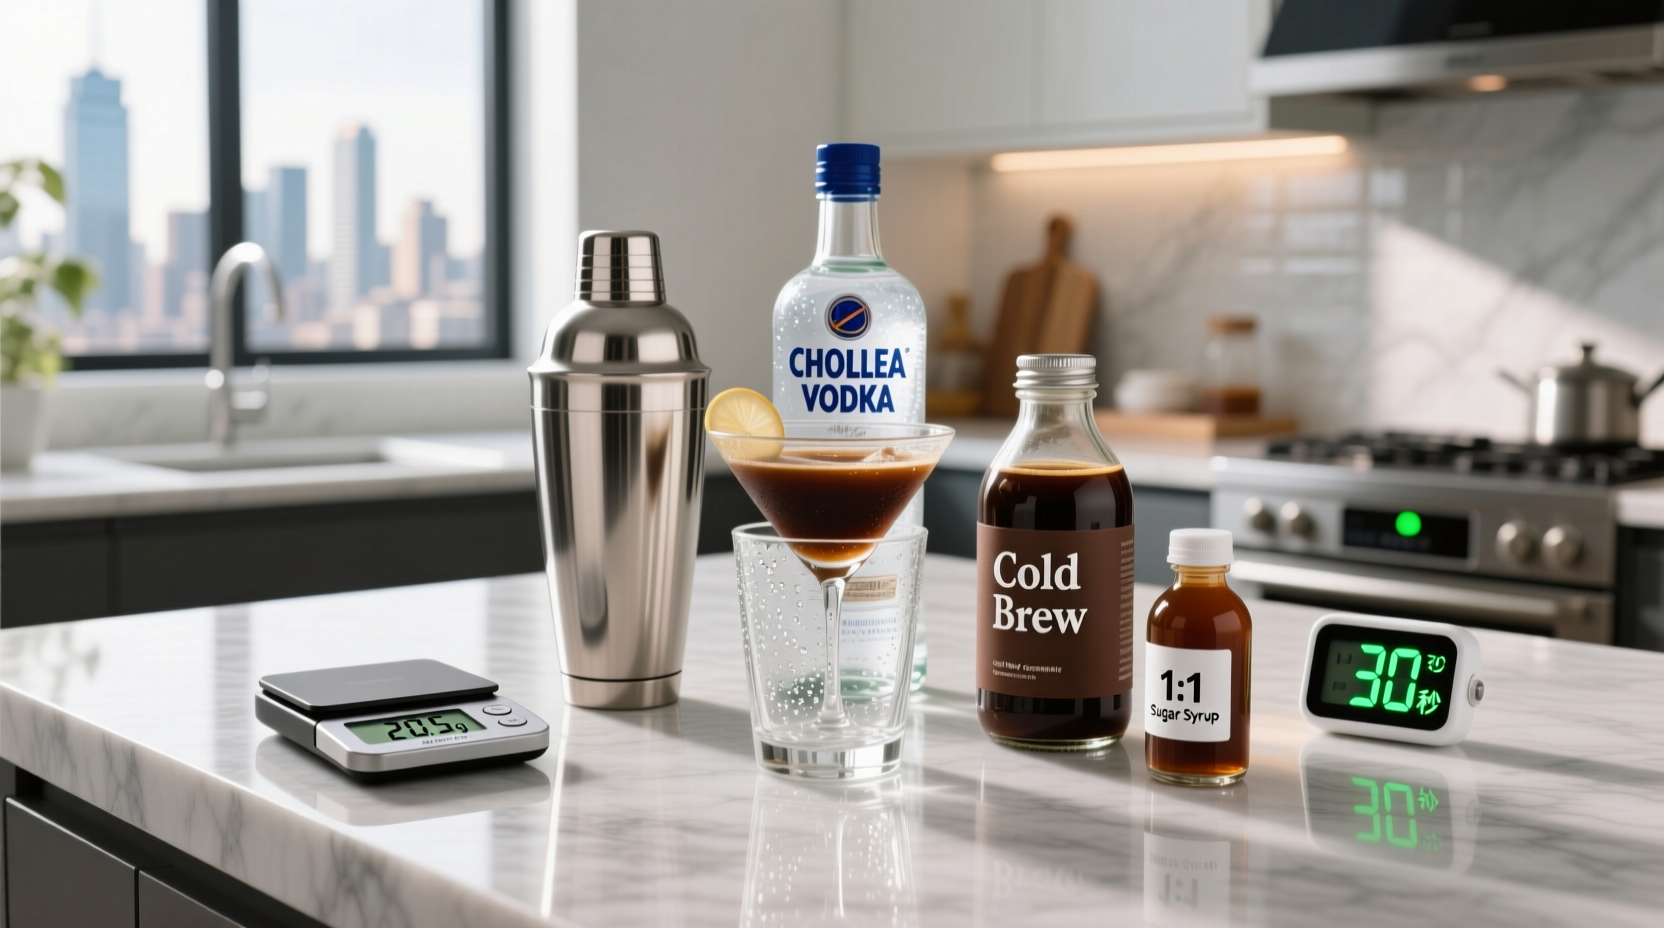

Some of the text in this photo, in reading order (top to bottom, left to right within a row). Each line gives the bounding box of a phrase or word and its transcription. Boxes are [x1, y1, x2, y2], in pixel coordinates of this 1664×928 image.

[801, 384, 895, 413] VODKA
[993, 551, 1081, 591] Cold
[992, 593, 1088, 634] Brew
[1161, 669, 1201, 703] 1:1
[1349, 644, 1422, 712] 30
[1416, 689, 1442, 715] 秒
[1150, 704, 1219, 725] Sugar Syrup
